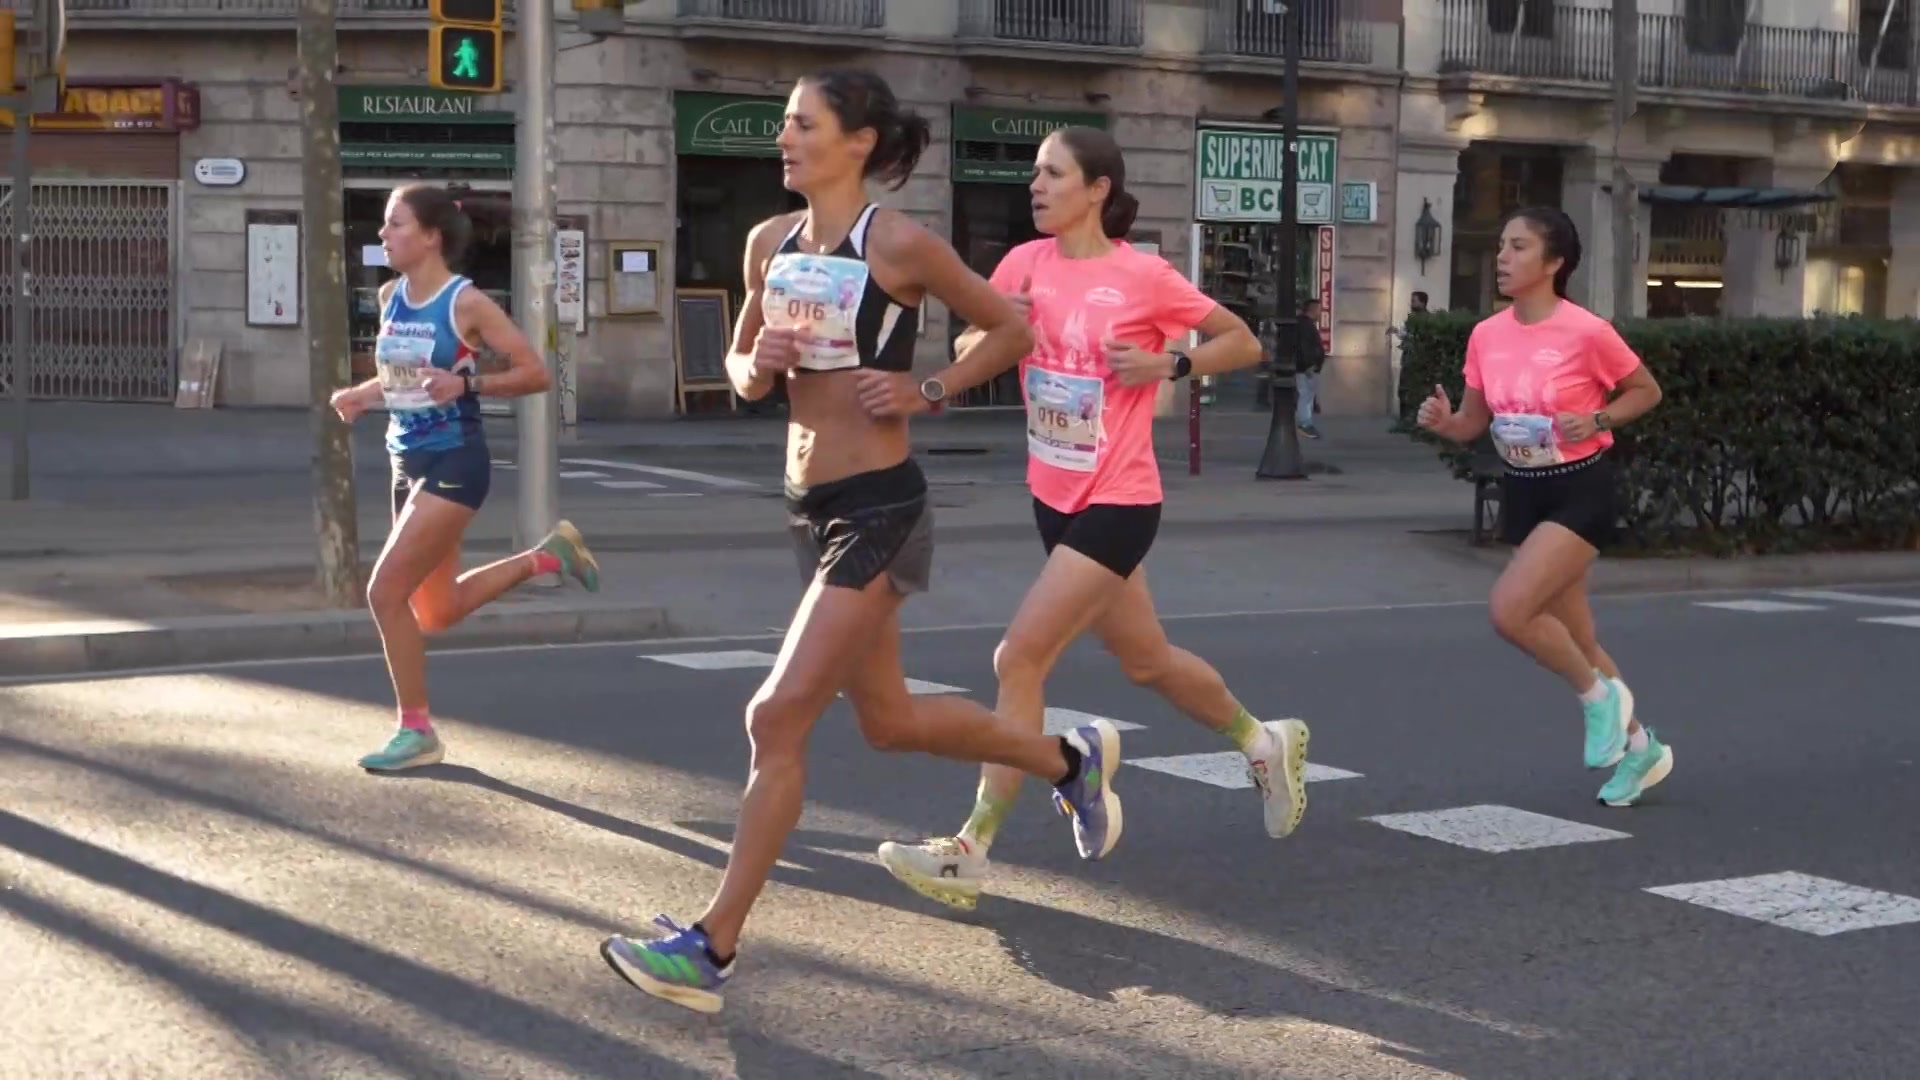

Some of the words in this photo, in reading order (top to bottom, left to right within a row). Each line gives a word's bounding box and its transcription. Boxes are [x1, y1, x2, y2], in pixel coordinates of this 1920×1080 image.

[363, 95, 473, 114] RESTAURANT
[1206, 136, 1329, 180] SUPERMECAT
[1240, 187, 1282, 212] BC
[788, 299, 824, 321] 016
[1038, 406, 1068, 429] 016
